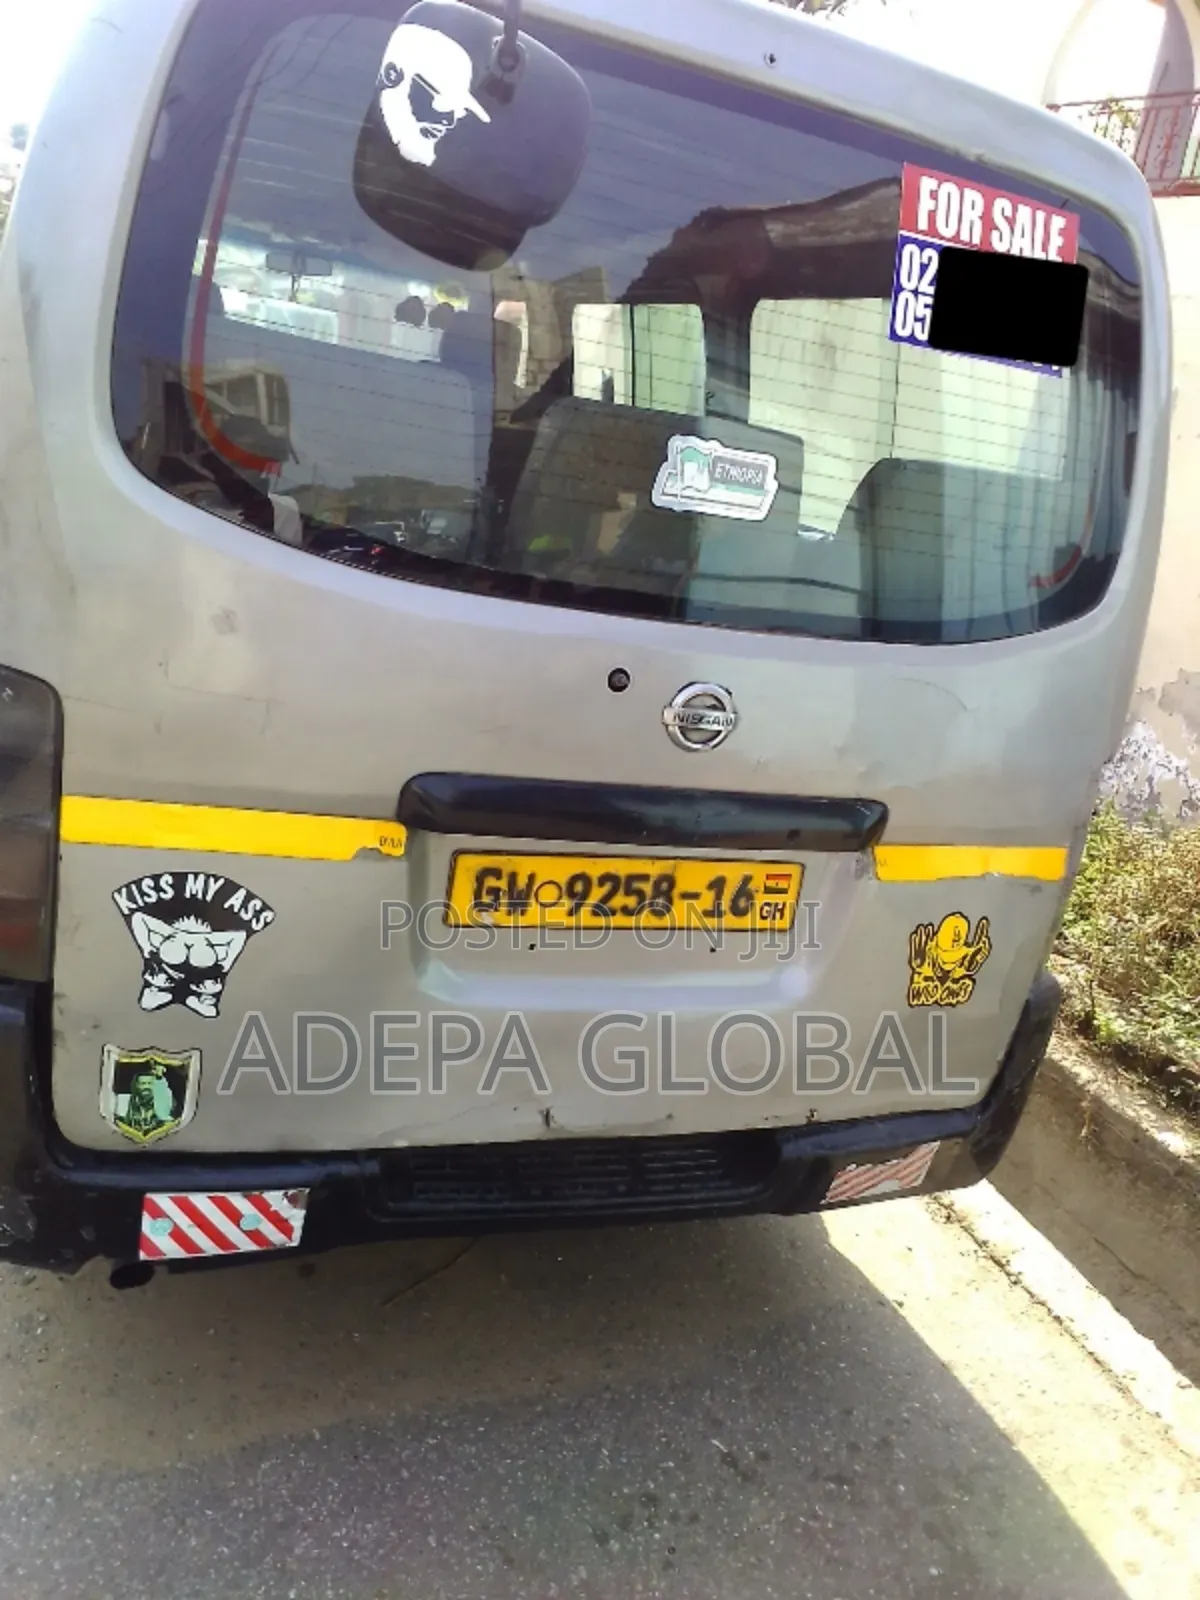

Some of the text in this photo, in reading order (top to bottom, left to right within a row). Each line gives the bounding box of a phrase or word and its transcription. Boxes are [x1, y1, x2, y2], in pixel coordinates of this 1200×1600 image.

[917, 175, 1067, 262] FOR SALE
[899, 243, 940, 294] 02
[673, 712, 733, 727] NISSAN
[113, 873, 274, 931] KISS MY ASS
[472, 867, 757, 921] GW 9258-16
[759, 901, 786, 921] GH
